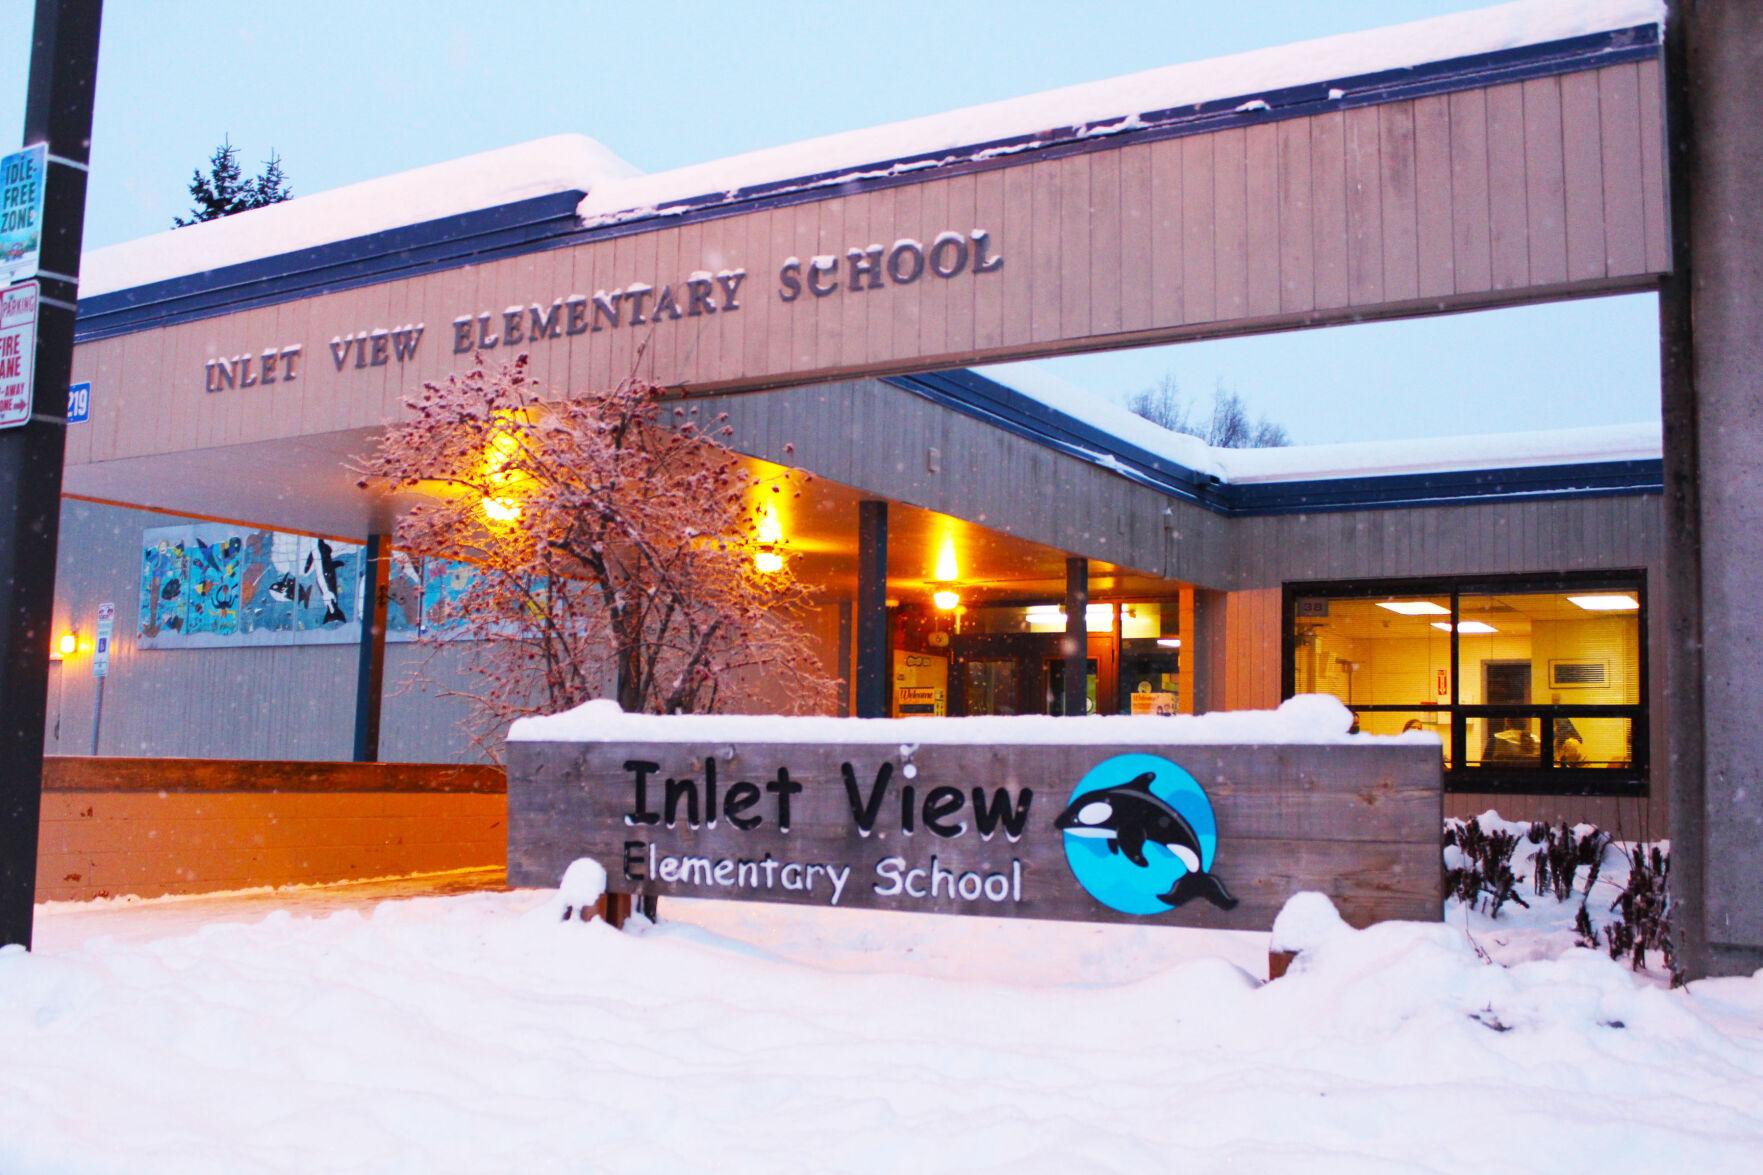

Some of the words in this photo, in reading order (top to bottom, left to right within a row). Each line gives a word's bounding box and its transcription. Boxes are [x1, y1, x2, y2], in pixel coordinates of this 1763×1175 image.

[3, 181, 36, 210] FREE
[5, 158, 37, 187] IDLE-
[1, 206, 34, 233] ZONE
[206, 345, 301, 393] INLET
[329, 323, 424, 372] VIEW
[453, 268, 746, 354] ELEMENTARY
[779, 229, 1003, 302] SCHOOL
[623, 757, 803, 834] Inlet
[840, 762, 1034, 843] View
[622, 841, 850, 905] Elementary
[872, 854, 1022, 902] School
